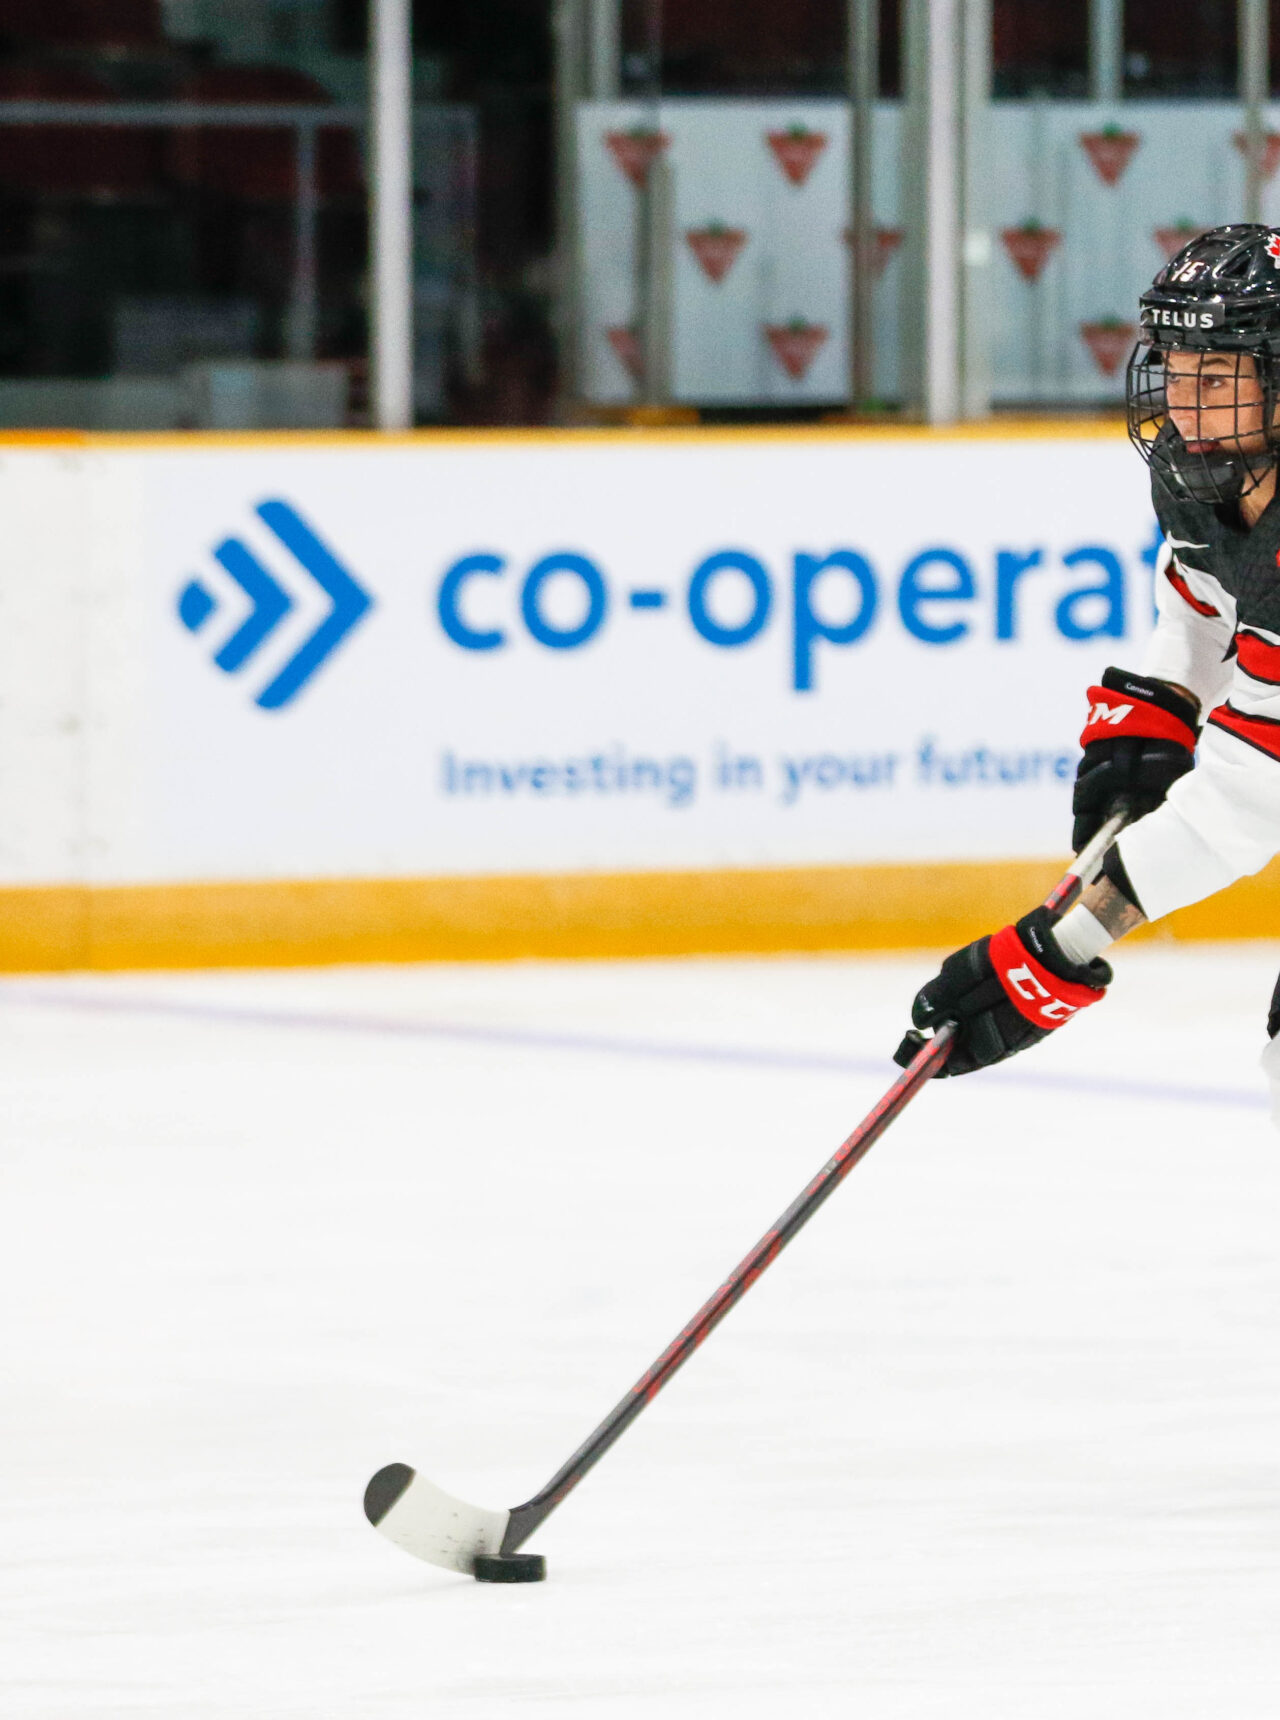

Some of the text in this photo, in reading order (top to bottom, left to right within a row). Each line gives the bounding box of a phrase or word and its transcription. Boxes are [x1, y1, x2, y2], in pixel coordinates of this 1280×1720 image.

[1171, 260, 1205, 283] 15
[1152, 308, 1214, 329] TELUS
[441, 744, 696, 808] Investing
[711, 736, 765, 790] in
[780, 752, 898, 805] your
